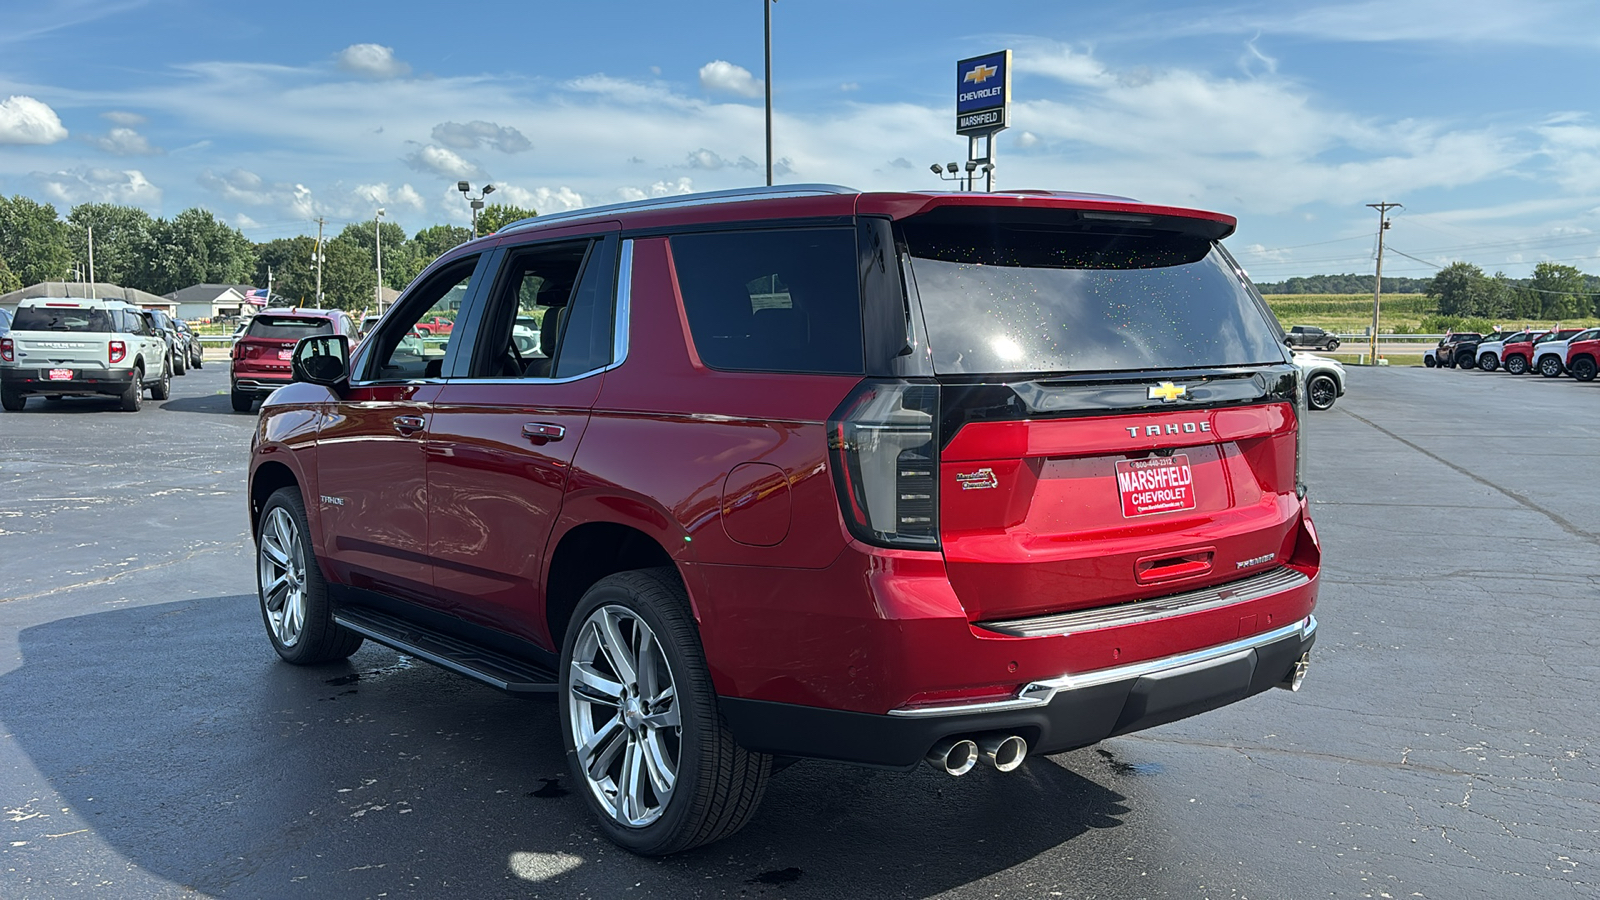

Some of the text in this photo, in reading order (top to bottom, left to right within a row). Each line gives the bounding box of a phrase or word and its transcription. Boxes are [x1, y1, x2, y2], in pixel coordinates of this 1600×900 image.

[960, 86, 1001, 102] CHEVROLET
[961, 112, 998, 127] MARSHFIELD
[1125, 421, 1211, 438] TAHOE
[1120, 465, 1191, 493] MARSHFIELD
[320, 495, 344, 505] TAHOE
[1131, 487, 1186, 505] CHEVROLET
[1236, 552, 1275, 569] PREMIER
